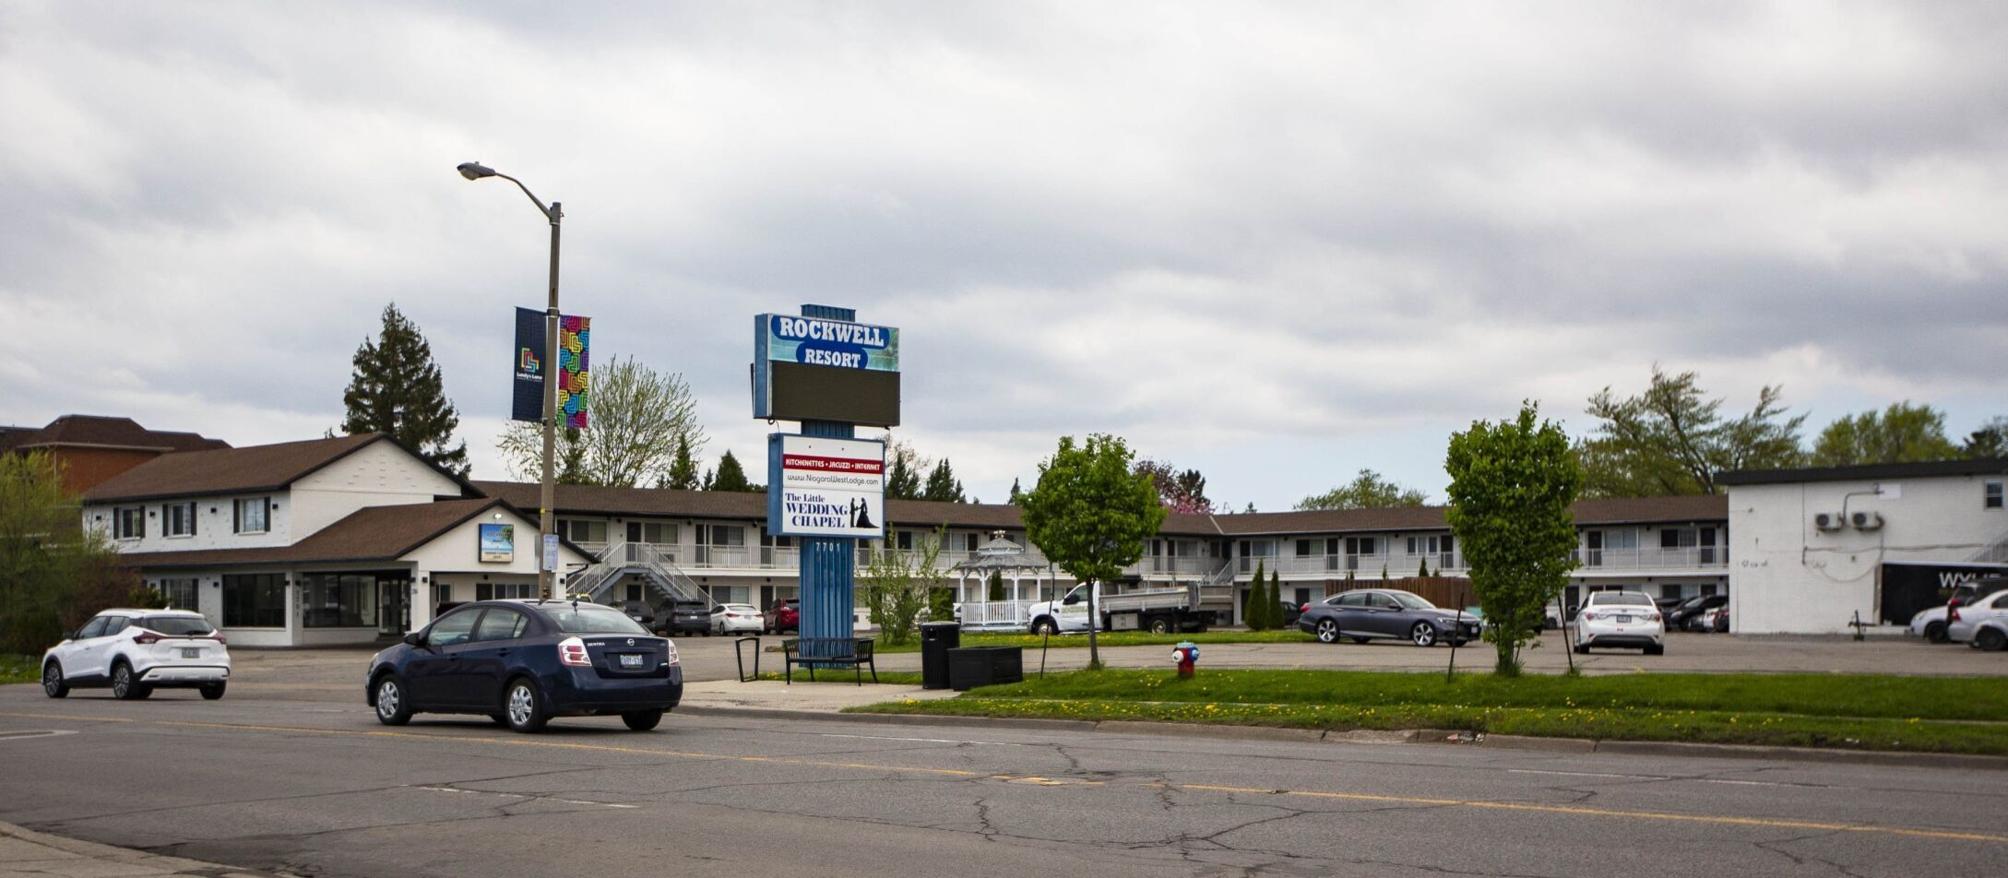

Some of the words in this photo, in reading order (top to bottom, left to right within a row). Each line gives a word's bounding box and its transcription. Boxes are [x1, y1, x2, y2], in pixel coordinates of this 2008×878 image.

[780, 318, 884, 346] ROCKWELL
[805, 348, 861, 368] RESORT
[785, 458, 824, 468] KITCHENETTES
[829, 461, 851, 469] JACUZZI
[855, 463, 880, 471] INTERNET
[785, 493, 802, 502] The
[804, 494, 826, 503] Little
[786, 503, 848, 515] WEDDING
[792, 515, 845, 528] CHAPEL
[815, 542, 841, 551] 7701
